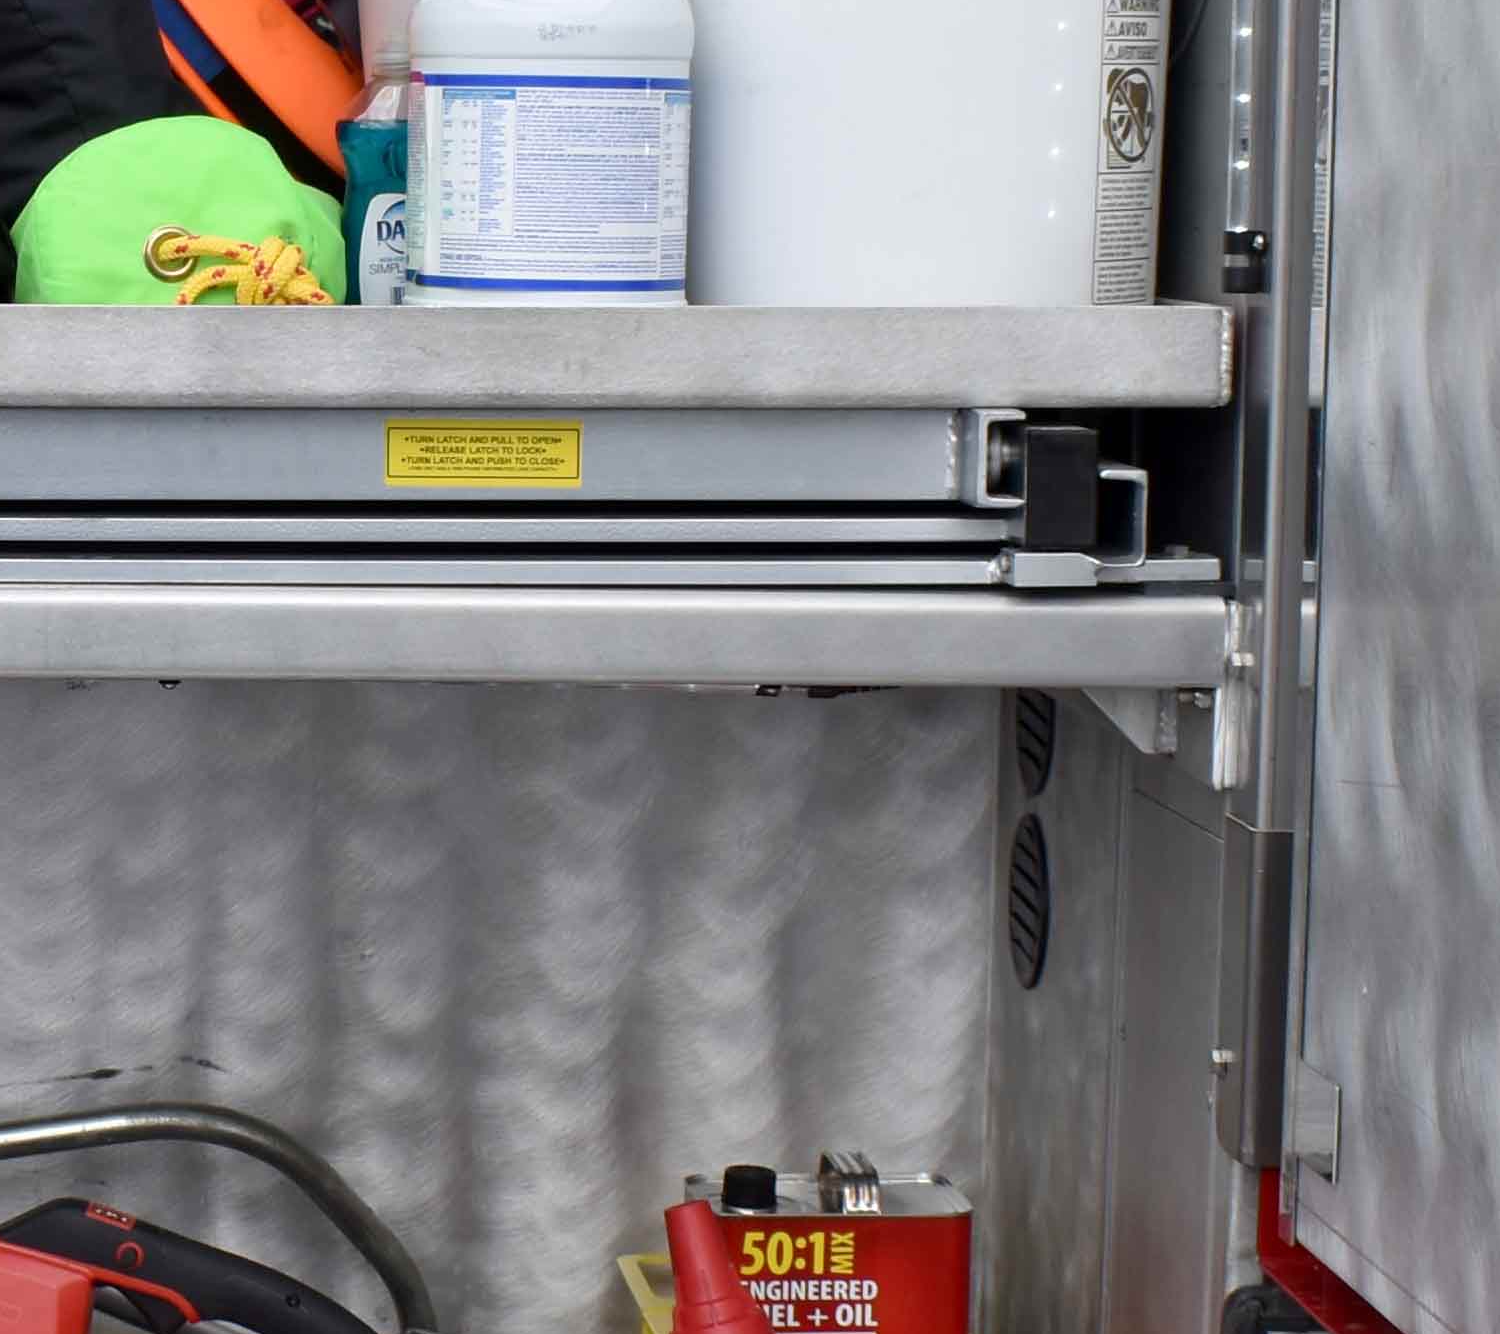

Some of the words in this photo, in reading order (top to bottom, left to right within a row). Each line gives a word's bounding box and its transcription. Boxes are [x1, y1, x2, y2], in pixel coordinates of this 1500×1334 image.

[410, 435, 434, 444] TURN
[436, 435, 467, 444] LATCH
[469, 436, 489, 444] AND
[491, 436, 512, 444] PULL
[516, 436, 529, 444] TO
[531, 437, 557, 445] OPEN
[424, 446, 465, 454] RELEASE
[468, 446, 499, 454] LATCH
[501, 446, 513, 454] TO
[515, 446, 541, 455] LOCK
[407, 456, 431, 465] TURN
[433, 456, 463, 465] LATCH
[465, 457, 485, 465] AND
[487, 457, 512, 465] PUSH
[515, 457, 527, 466] TO
[529, 457, 560, 466] CLOSE
[740, 1231, 825, 1275] 50:1
[830, 1232, 855, 1274] MIX
[740, 1279, 878, 1300] NGINEERED
[761, 1304, 801, 1327] EL
[835, 1304, 878, 1327] OIL
